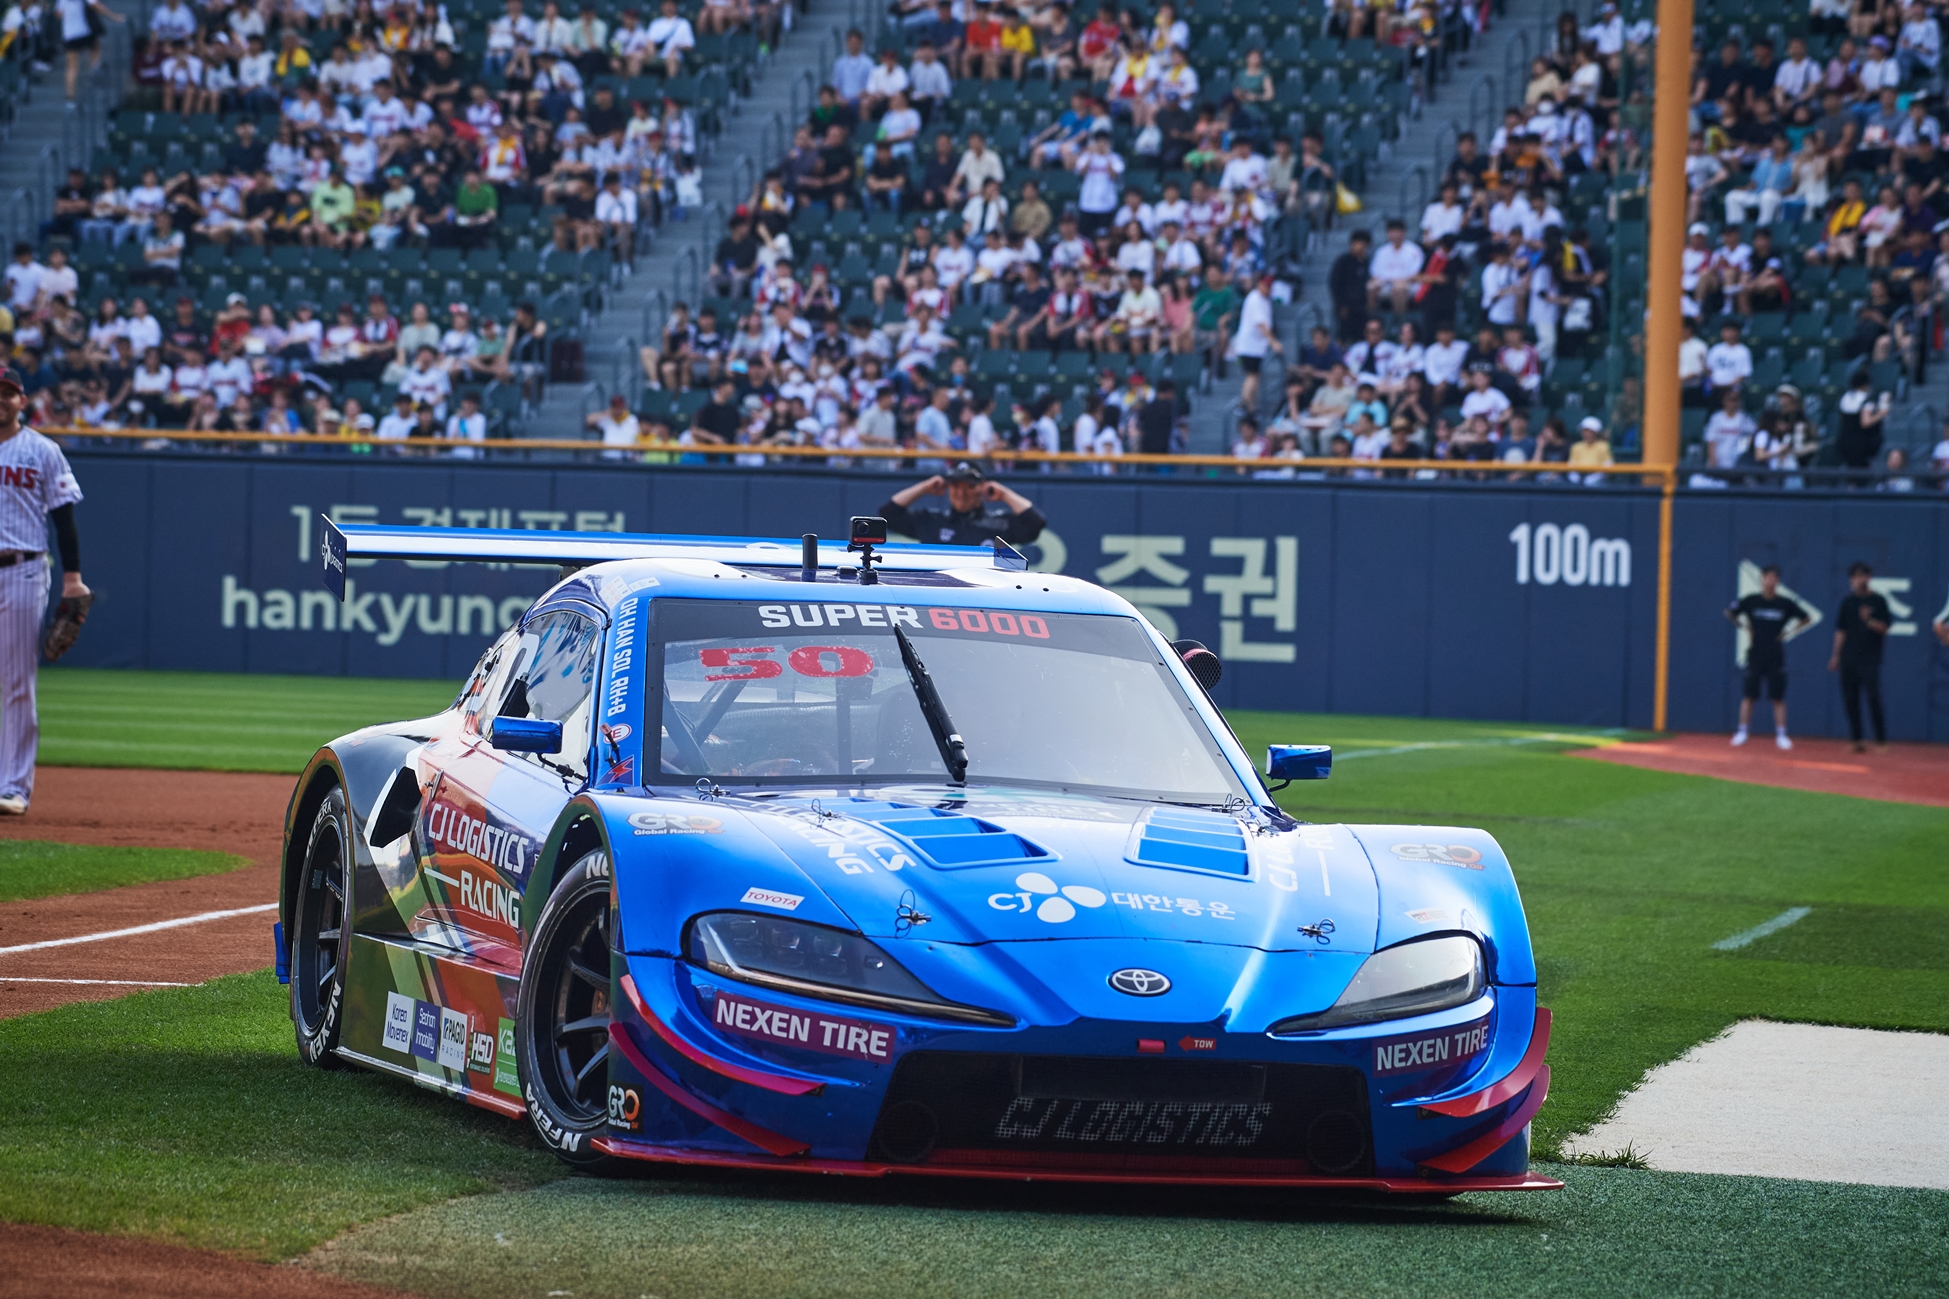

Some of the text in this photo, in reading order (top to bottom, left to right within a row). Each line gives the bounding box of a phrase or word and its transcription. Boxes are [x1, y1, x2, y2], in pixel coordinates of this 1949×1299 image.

[1508, 521, 1631, 586] 100m
[614, 617, 636, 651] HAN
[758, 603, 1051, 639] SUPER 6000
[611, 648, 632, 679] SOL
[699, 645, 875, 682] 50
[607, 676, 629, 718] RH+B
[428, 802, 449, 841] CJ
[447, 809, 529, 874] LOGISTICS
[633, 828, 667, 836] Global
[669, 828, 706, 836] Racing
[1433, 858, 1467, 869] Racing
[461, 869, 520, 929] RACING
[747, 891, 798, 906] TOYOTA
[987, 891, 1237, 921] CJ 대한통운
[391, 1002, 408, 1023] Korea
[716, 998, 890, 1057] NEXEN TIRE
[1194, 1039, 1214, 1048] TOW
[1377, 1024, 1489, 1071] NEXEN TIRE
[994, 1096, 1273, 1147] CJ LOGISTICS
